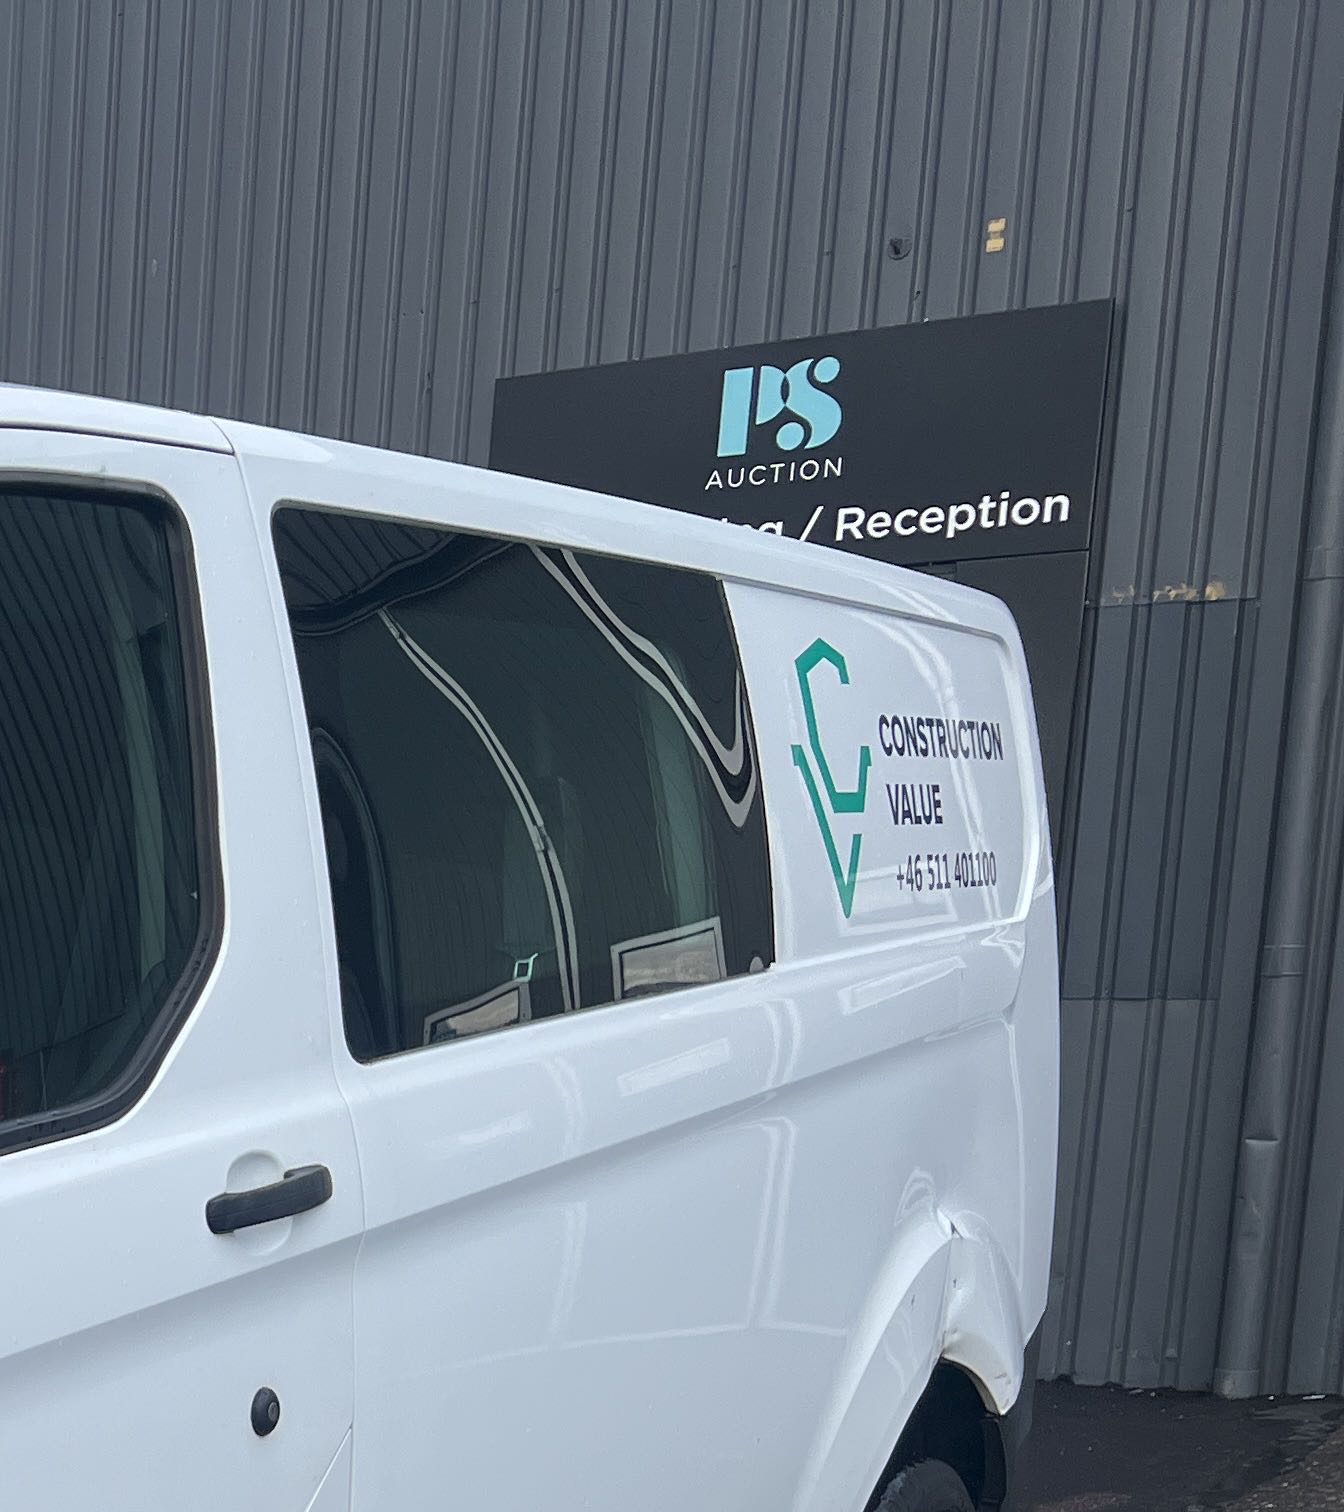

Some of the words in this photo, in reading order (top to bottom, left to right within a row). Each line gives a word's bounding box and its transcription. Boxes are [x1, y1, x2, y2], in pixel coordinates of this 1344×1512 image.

[716, 355, 843, 458] PS
[704, 457, 844, 491] AUCTION
[834, 491, 1071, 542] Reception
[878, 713, 1005, 761] CONSTRUCTION
[885, 783, 944, 826] VALUE
[896, 854, 924, 892] +46
[926, 853, 952, 891] 511
[954, 851, 998, 889] 401100
